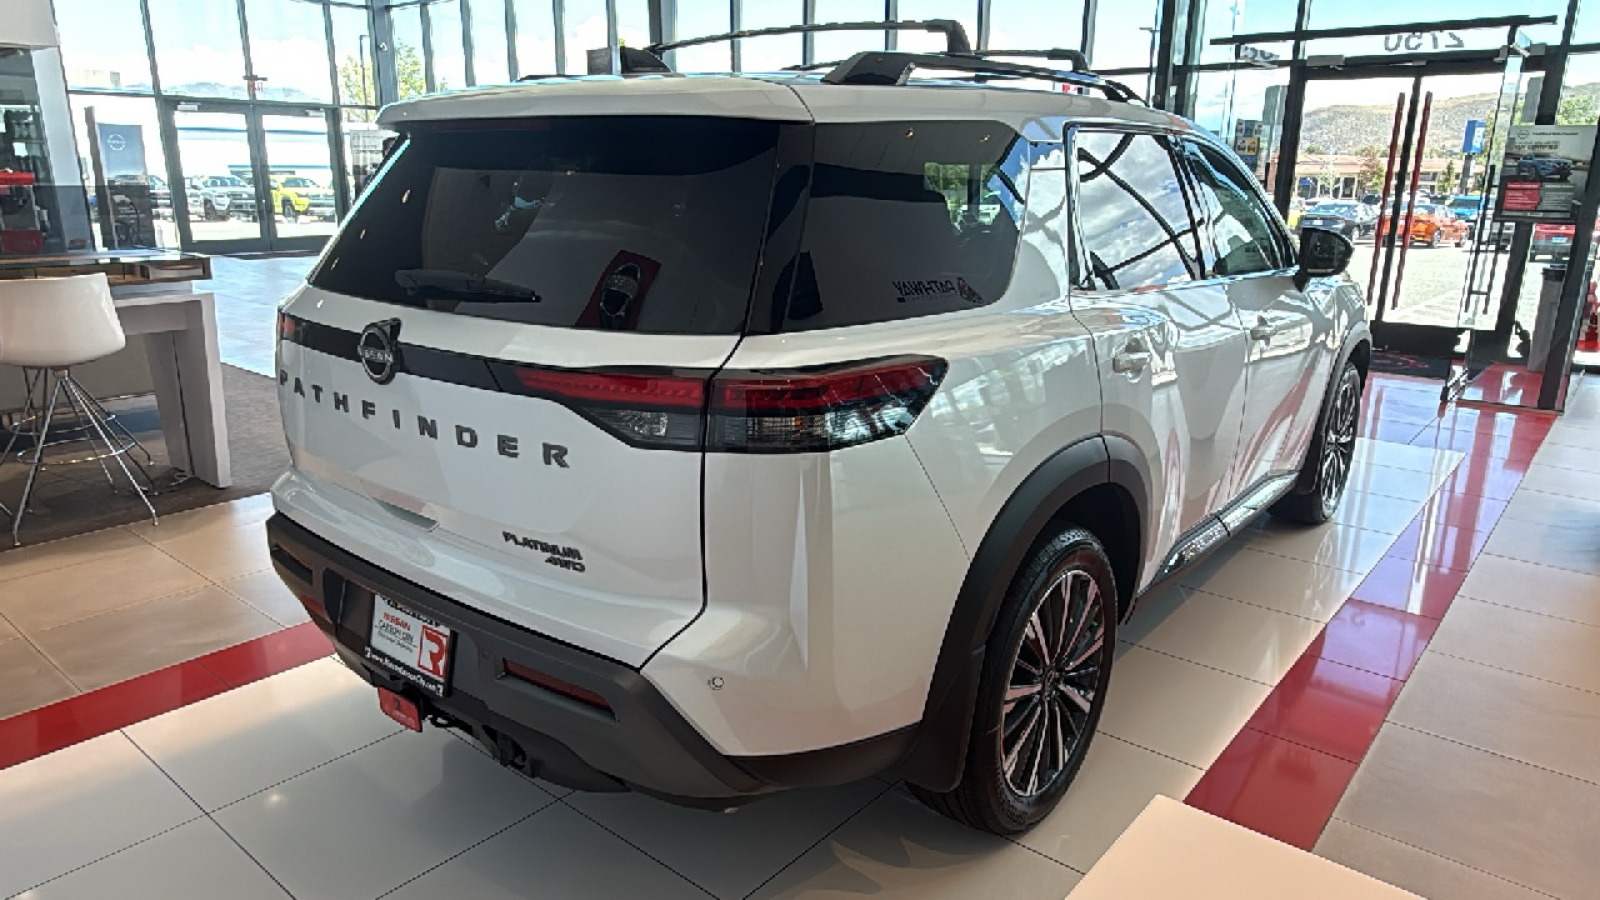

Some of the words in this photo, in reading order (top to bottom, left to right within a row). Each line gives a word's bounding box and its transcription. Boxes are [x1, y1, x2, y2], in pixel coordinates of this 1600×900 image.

[279, 369, 570, 469] PATHFINDER
[502, 531, 583, 560] PLATINUM
[383, 612, 411, 631] NISSAN
